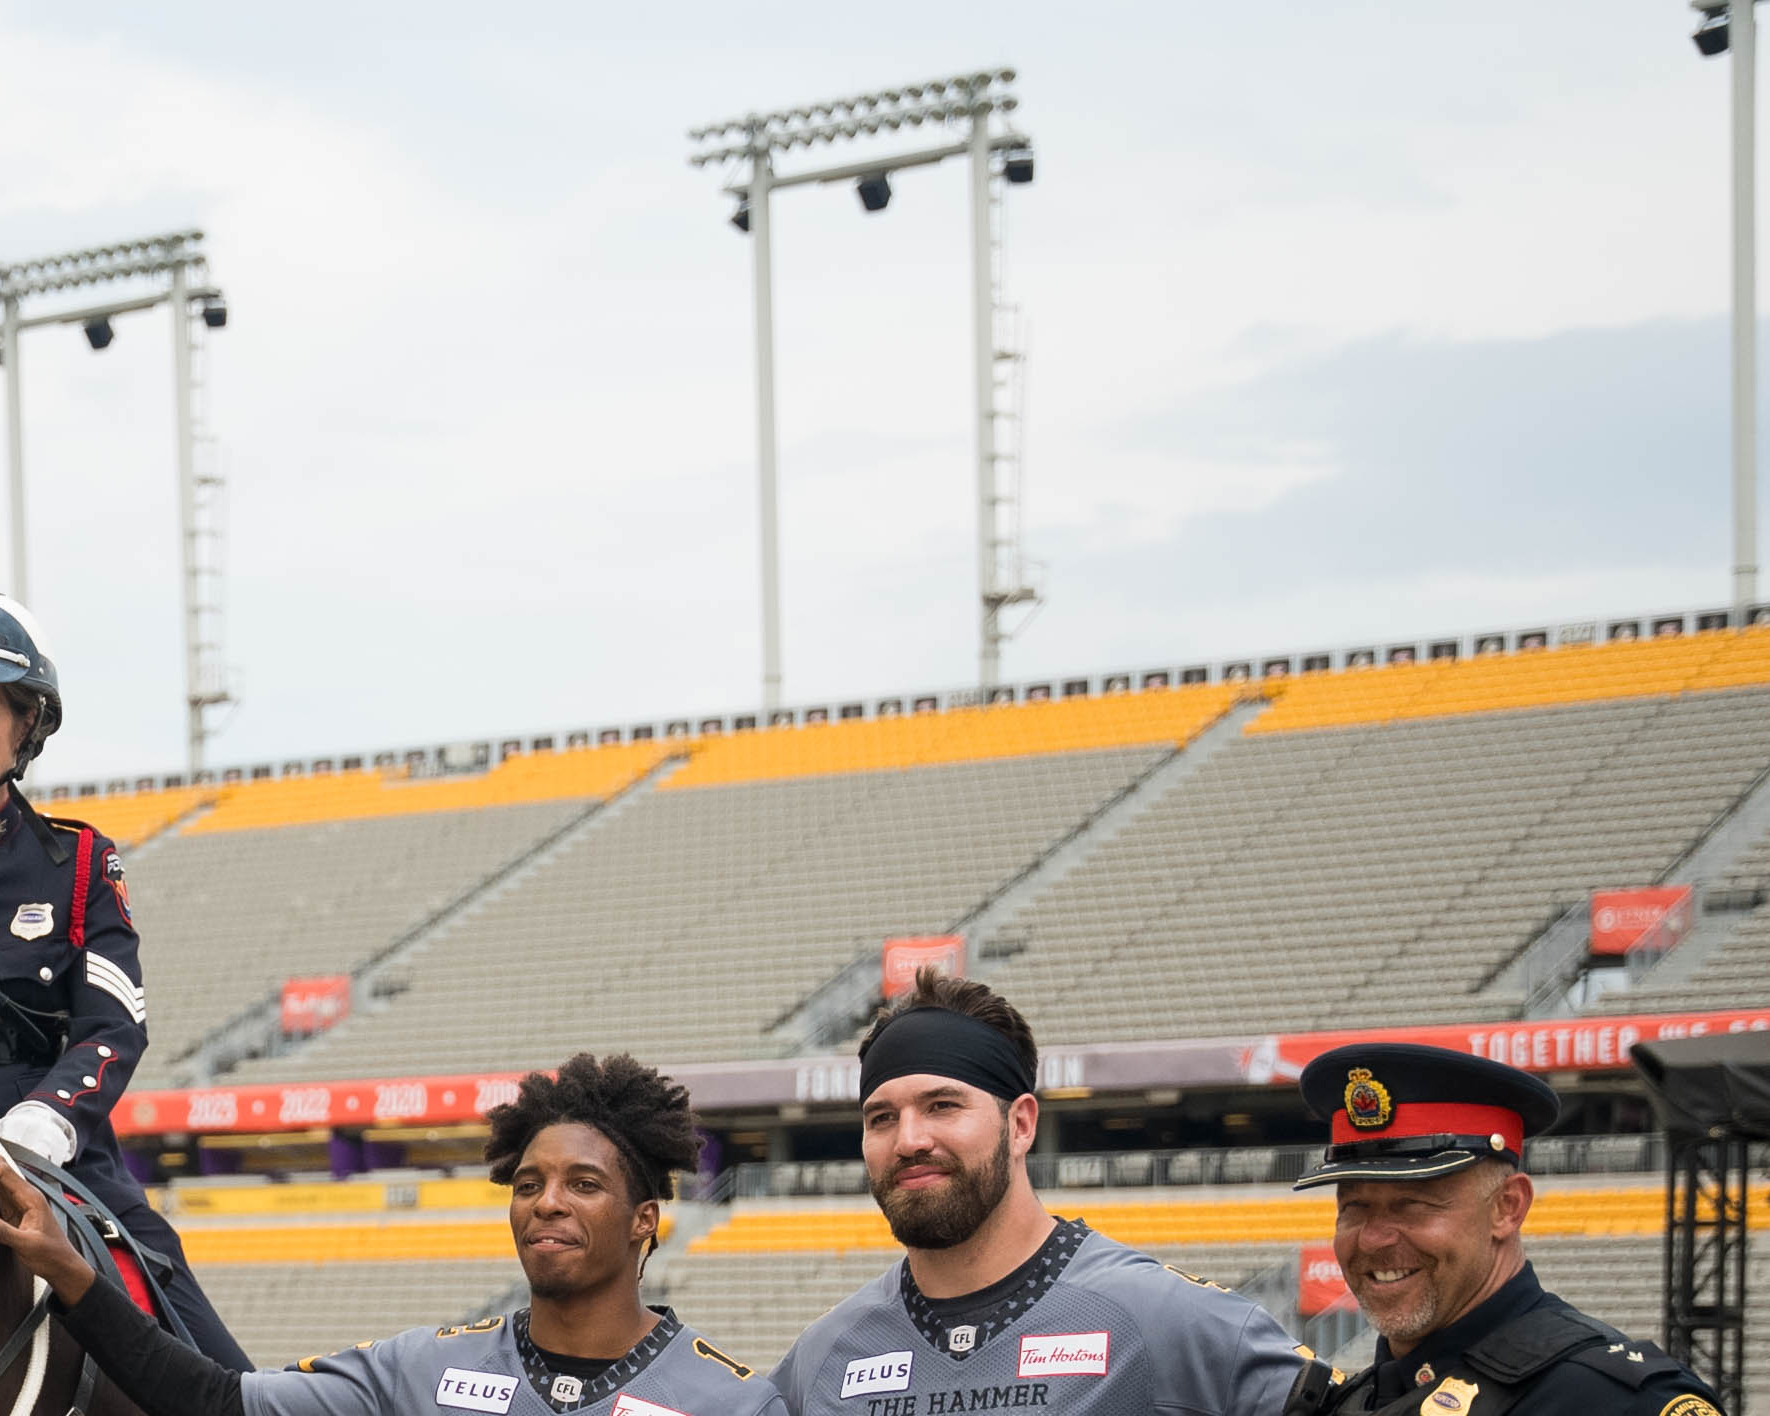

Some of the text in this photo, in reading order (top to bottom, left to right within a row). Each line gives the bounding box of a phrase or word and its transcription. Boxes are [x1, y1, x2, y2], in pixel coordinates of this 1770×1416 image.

[1469, 1025, 1639, 1069] TOGETHER
[954, 1332, 971, 1345] CFL
[1022, 1349, 1048, 1366] Tim
[846, 1363, 909, 1386] TELUS
[442, 1378, 512, 1401] TELUS
[556, 1380, 576, 1397] CFL
[927, 1384, 1050, 1416] HAMMER
